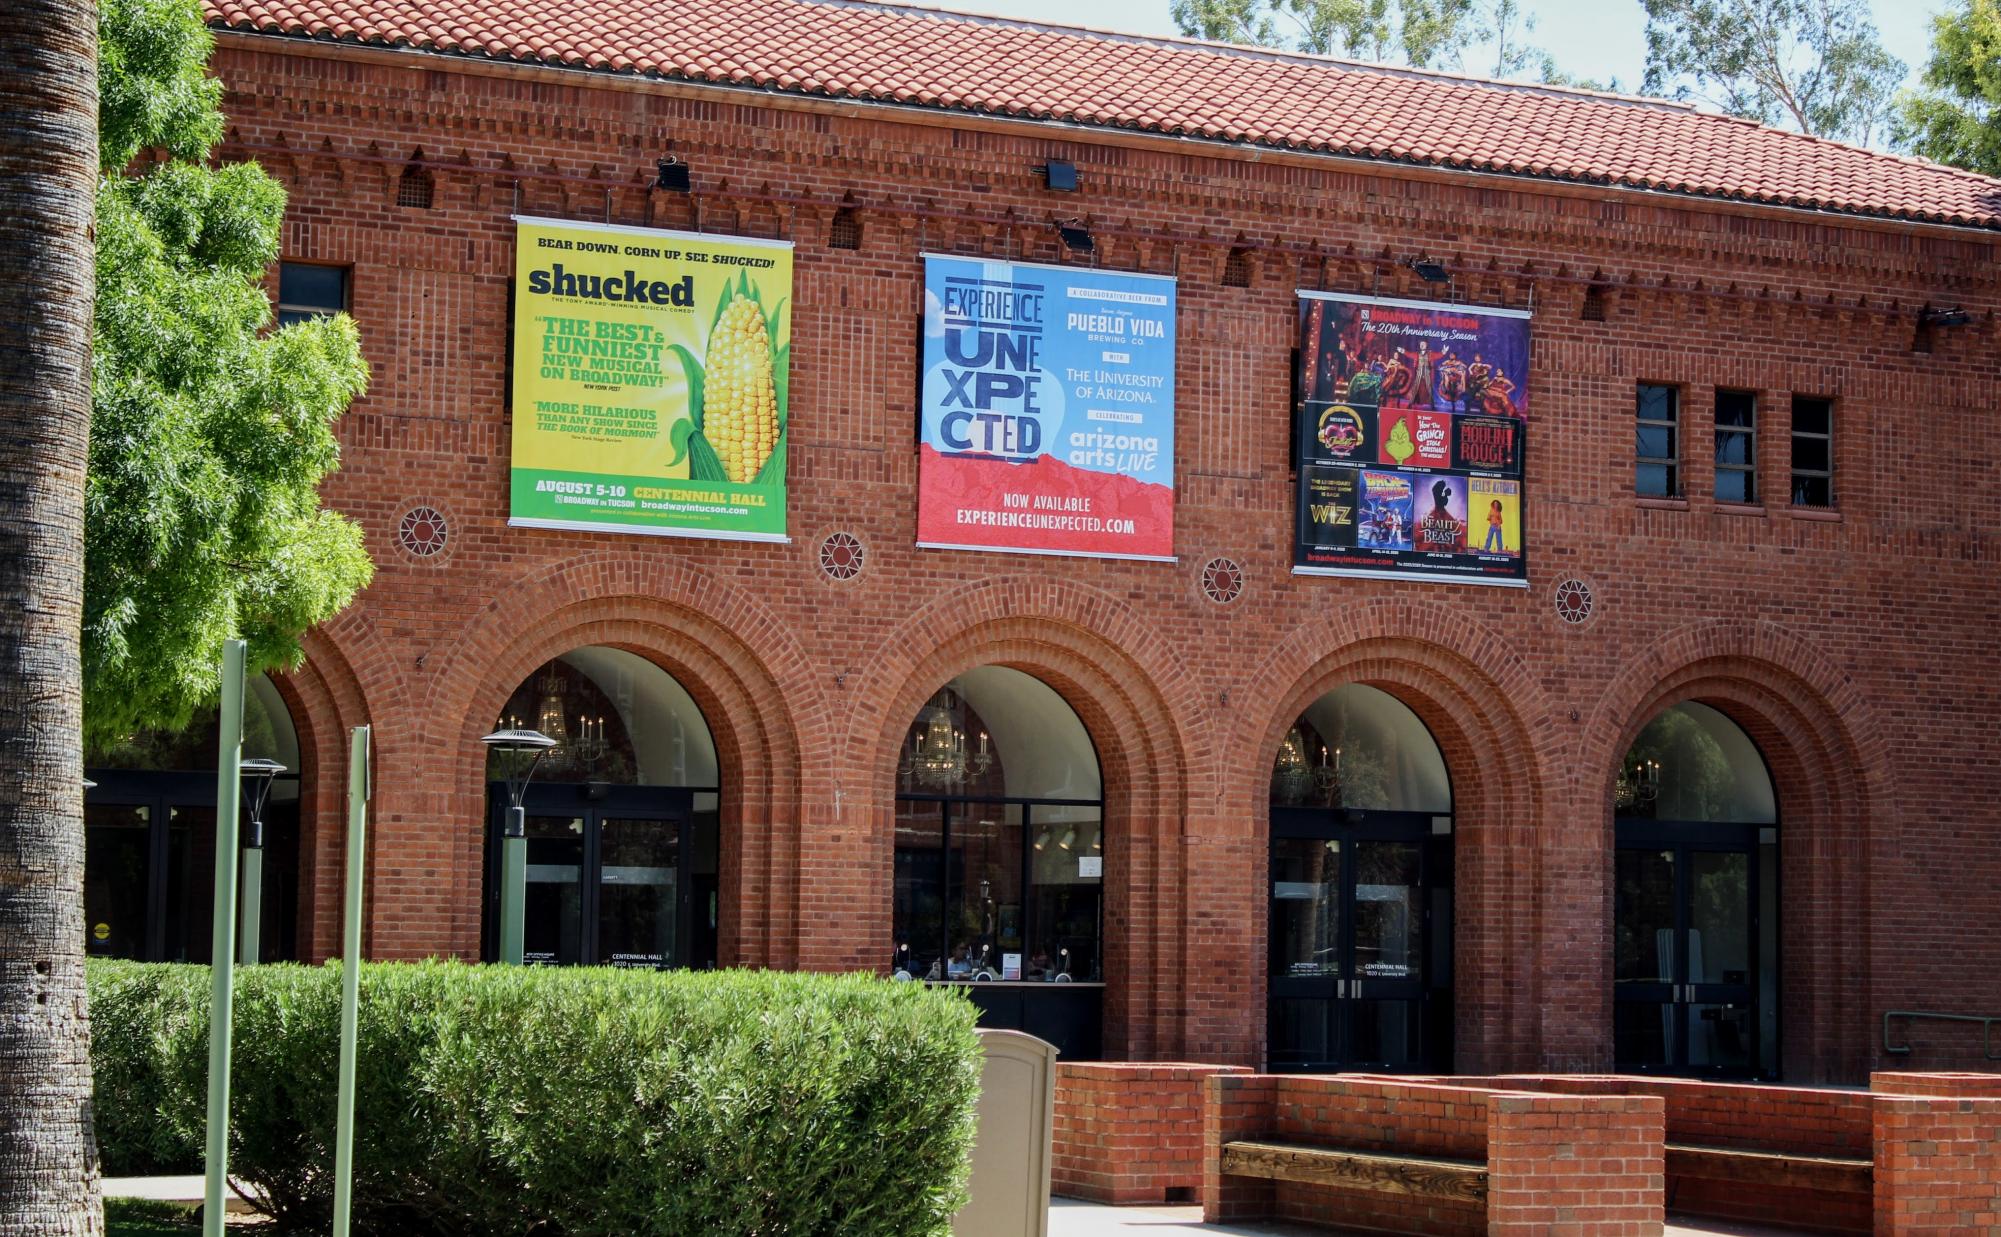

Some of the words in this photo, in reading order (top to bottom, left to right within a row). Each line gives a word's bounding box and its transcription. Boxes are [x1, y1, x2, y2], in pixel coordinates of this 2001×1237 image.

[538, 238, 573, 250] BEAR
[576, 241, 621, 255] DOWN.
[624, 246, 660, 259] CORN
[664, 250, 682, 261] UP.
[685, 252, 709, 263] SEE
[712, 254, 775, 269] SHUCKED!
[528, 263, 694, 307] shucked
[944, 286, 1044, 323] EXPERIENCE
[1079, 290, 1126, 300] COLLABORATIVE
[1144, 295, 1161, 303] FROM
[1067, 313, 1124, 334] PUEBLO
[1130, 318, 1164, 338] VIDA
[1371, 308, 1420, 324] BROADWAY
[1436, 316, 1479, 329] TUCSON
[595, 321, 654, 342] BEST
[654, 332, 665, 343] &
[1088, 334, 1126, 344] BREWING
[1361, 322, 1376, 332] The
[1377, 322, 1400, 334] 20th
[1400, 326, 1449, 341] Anniversary
[1449, 330, 1478, 341] Season
[542, 335, 663, 361] FUNNIEST
[944, 328, 1042, 372] UNE
[540, 366, 564, 380] ON
[542, 353, 584, 368] NEW
[589, 358, 662, 374] MUSICAL
[1066, 368, 1091, 383] THE
[1095, 370, 1164, 388] UNIVERSITY
[940, 369, 1042, 413] XPE
[1075, 386, 1093, 399] OF
[536, 413, 567, 423] THAN
[569, 416, 590, 425] ANY
[593, 417, 624, 427] SHOW
[626, 420, 658, 430] SINCE
[582, 405, 656, 420] HILARIOUS
[1096, 410, 1134, 421] CELEBRATING
[536, 422, 558, 431] THE
[560, 424, 587, 434] BOOK
[589, 427, 603, 435] OF
[940, 411, 1041, 454] CTED
[1416, 429, 1445, 442] GRINCH
[1070, 427, 1158, 452] arizona
[1070, 448, 1115, 467] arts
[1117, 452, 1158, 472] LIVE
[536, 480, 593, 495] AUGUST
[596, 485, 626, 497] 5-10
[633, 487, 727, 504] CENTENNIAL
[730, 493, 766, 506] HALL
[563, 495, 600, 506] BROADWAY
[608, 499, 636, 508] TUCSON
[641, 501, 748, 515] broadwayintucson.com
[1003, 493, 1029, 508] NOW
[1033, 495, 1091, 512] AVAILABLE
[957, 509, 1135, 534] EXPERIENCEUNEXPECTED.COM
[1310, 504, 1352, 525] WIZ
[1420, 529, 1461, 544] BEAST
[1307, 552, 1394, 566] broadwayintucson.com
